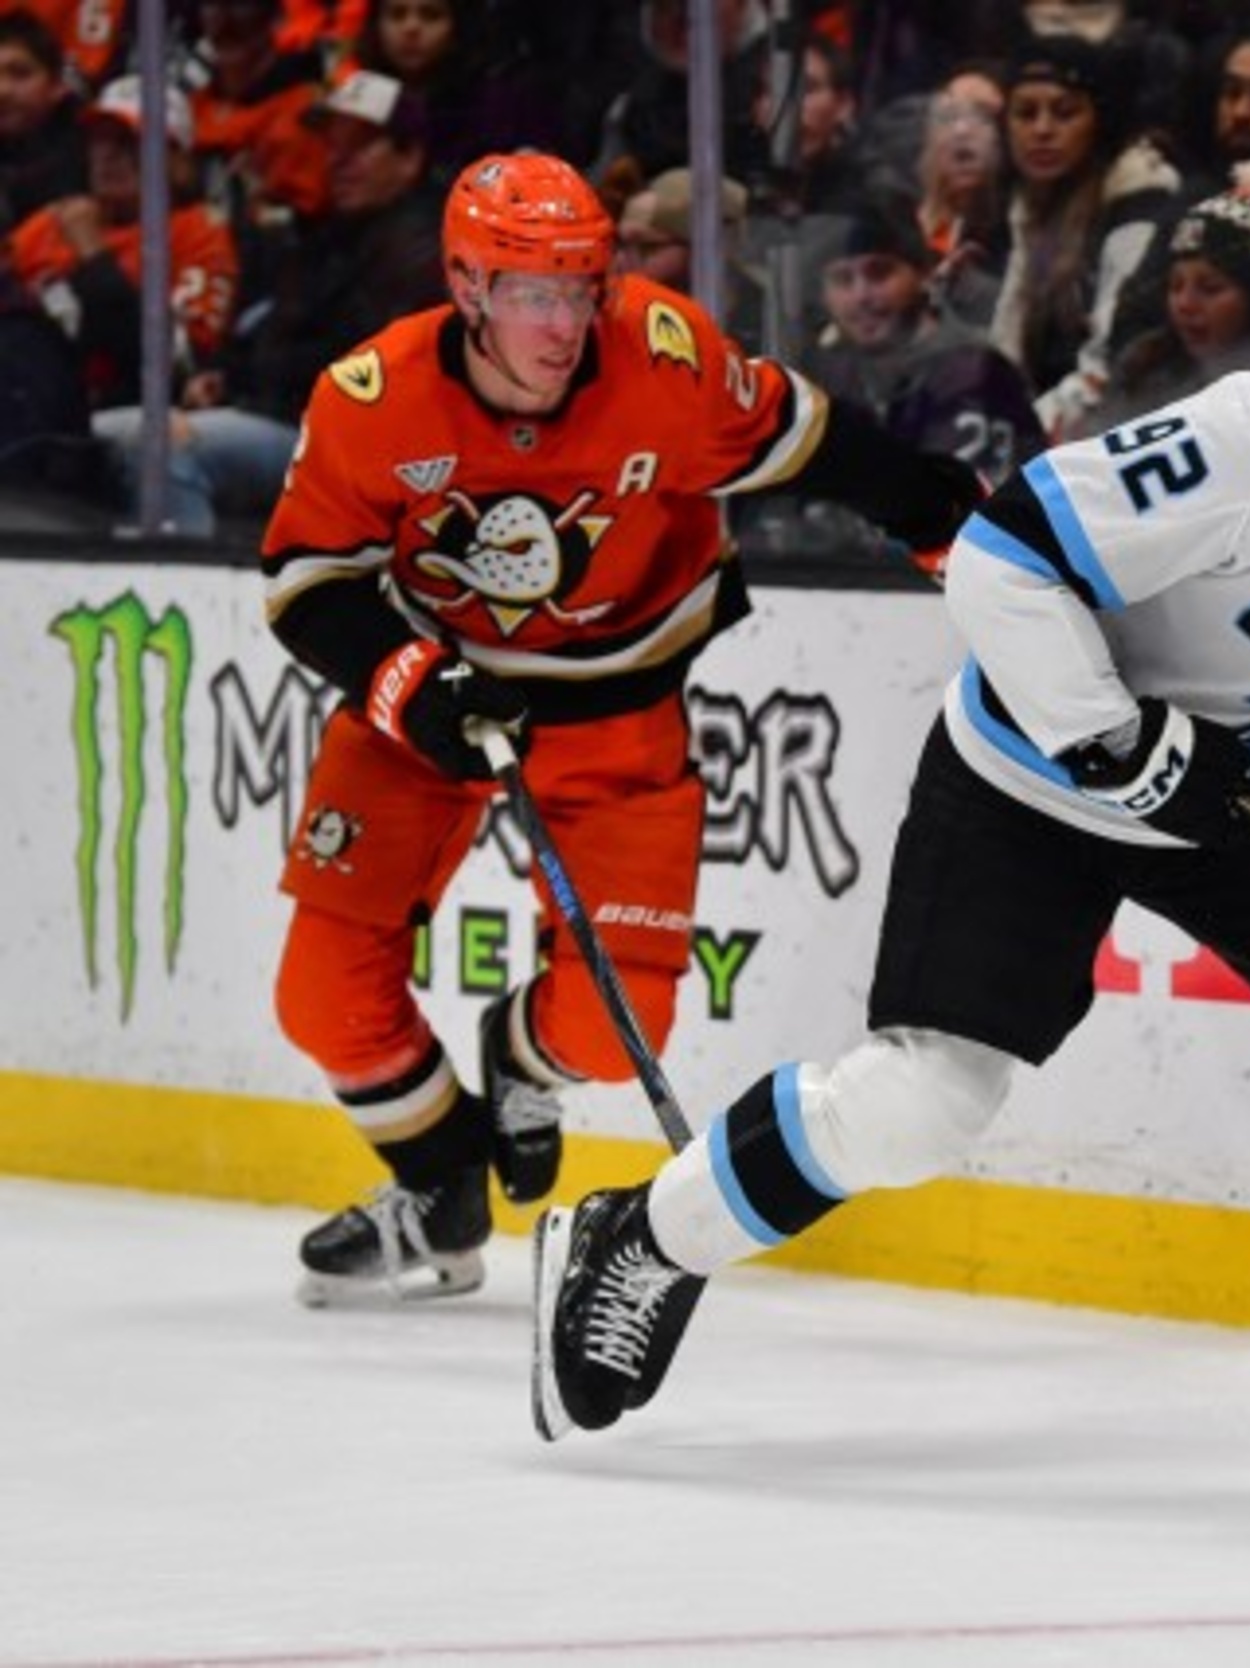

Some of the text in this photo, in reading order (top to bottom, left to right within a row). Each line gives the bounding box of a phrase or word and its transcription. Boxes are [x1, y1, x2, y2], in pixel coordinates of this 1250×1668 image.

[616, 451, 658, 498] A
[1104, 416, 1209, 515] 92
[373, 643, 424, 734] UER
[1121, 743, 1185, 812] CM
[593, 902, 693, 931] BAUE
